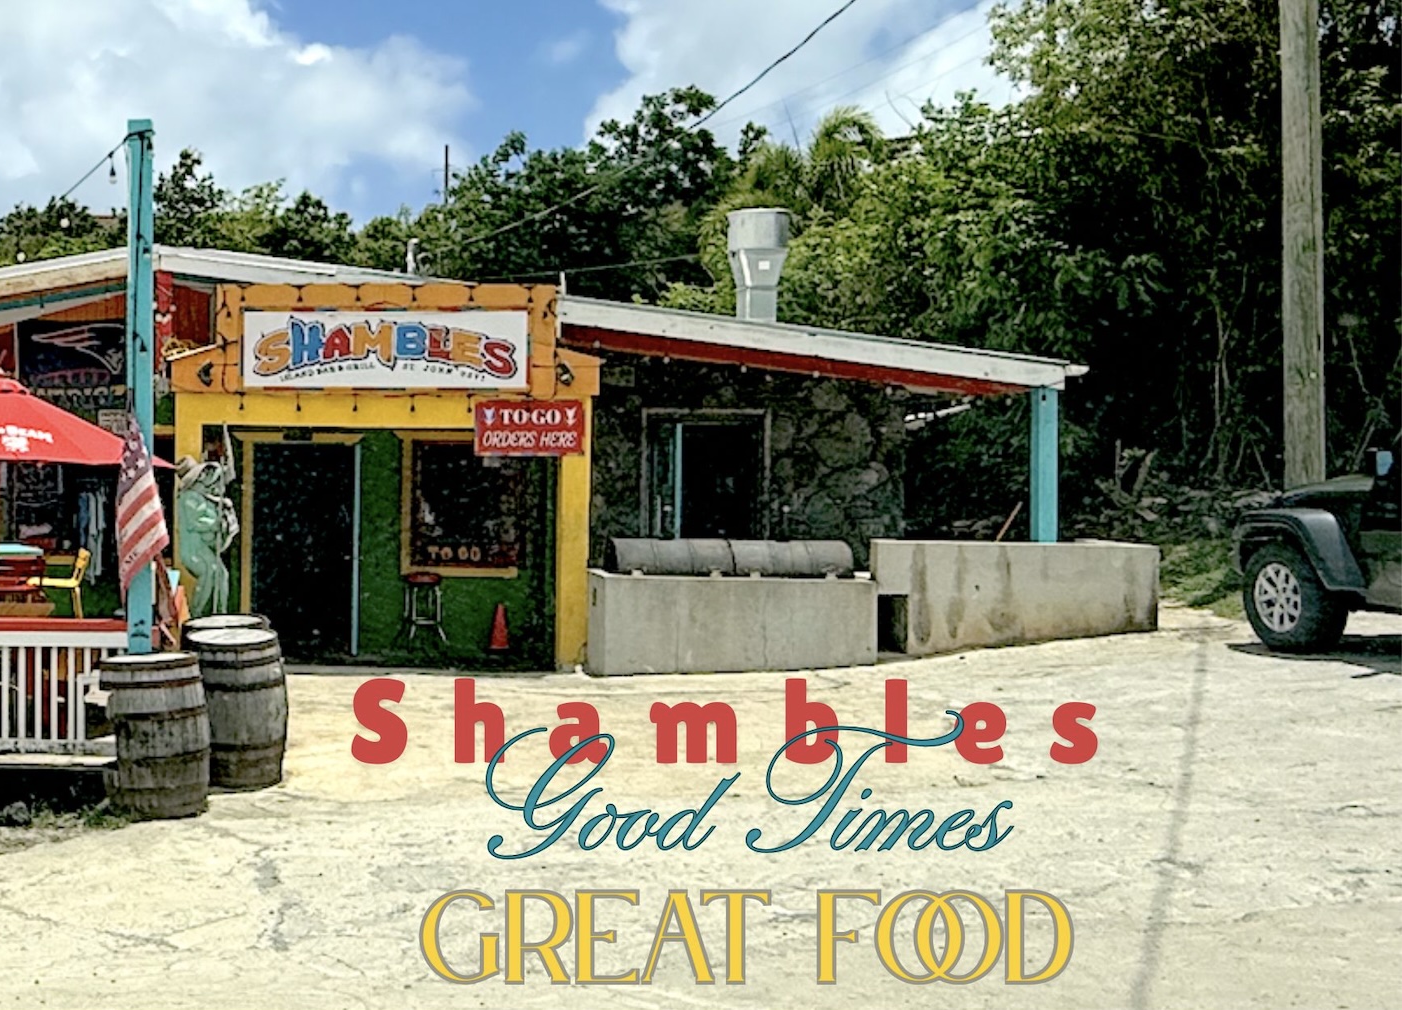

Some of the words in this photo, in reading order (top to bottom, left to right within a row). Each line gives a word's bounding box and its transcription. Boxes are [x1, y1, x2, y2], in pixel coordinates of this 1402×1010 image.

[254, 315, 518, 379] SHAMBLES
[280, 370, 315, 382] ISLAND
[316, 366, 336, 376] BAR
[346, 362, 376, 371] GRILL
[499, 408, 528, 426] TO
[530, 408, 562, 426] GO
[5, 425, 54, 443] BEAM
[482, 431, 538, 448] ORDERS
[539, 431, 578, 448] HERE
